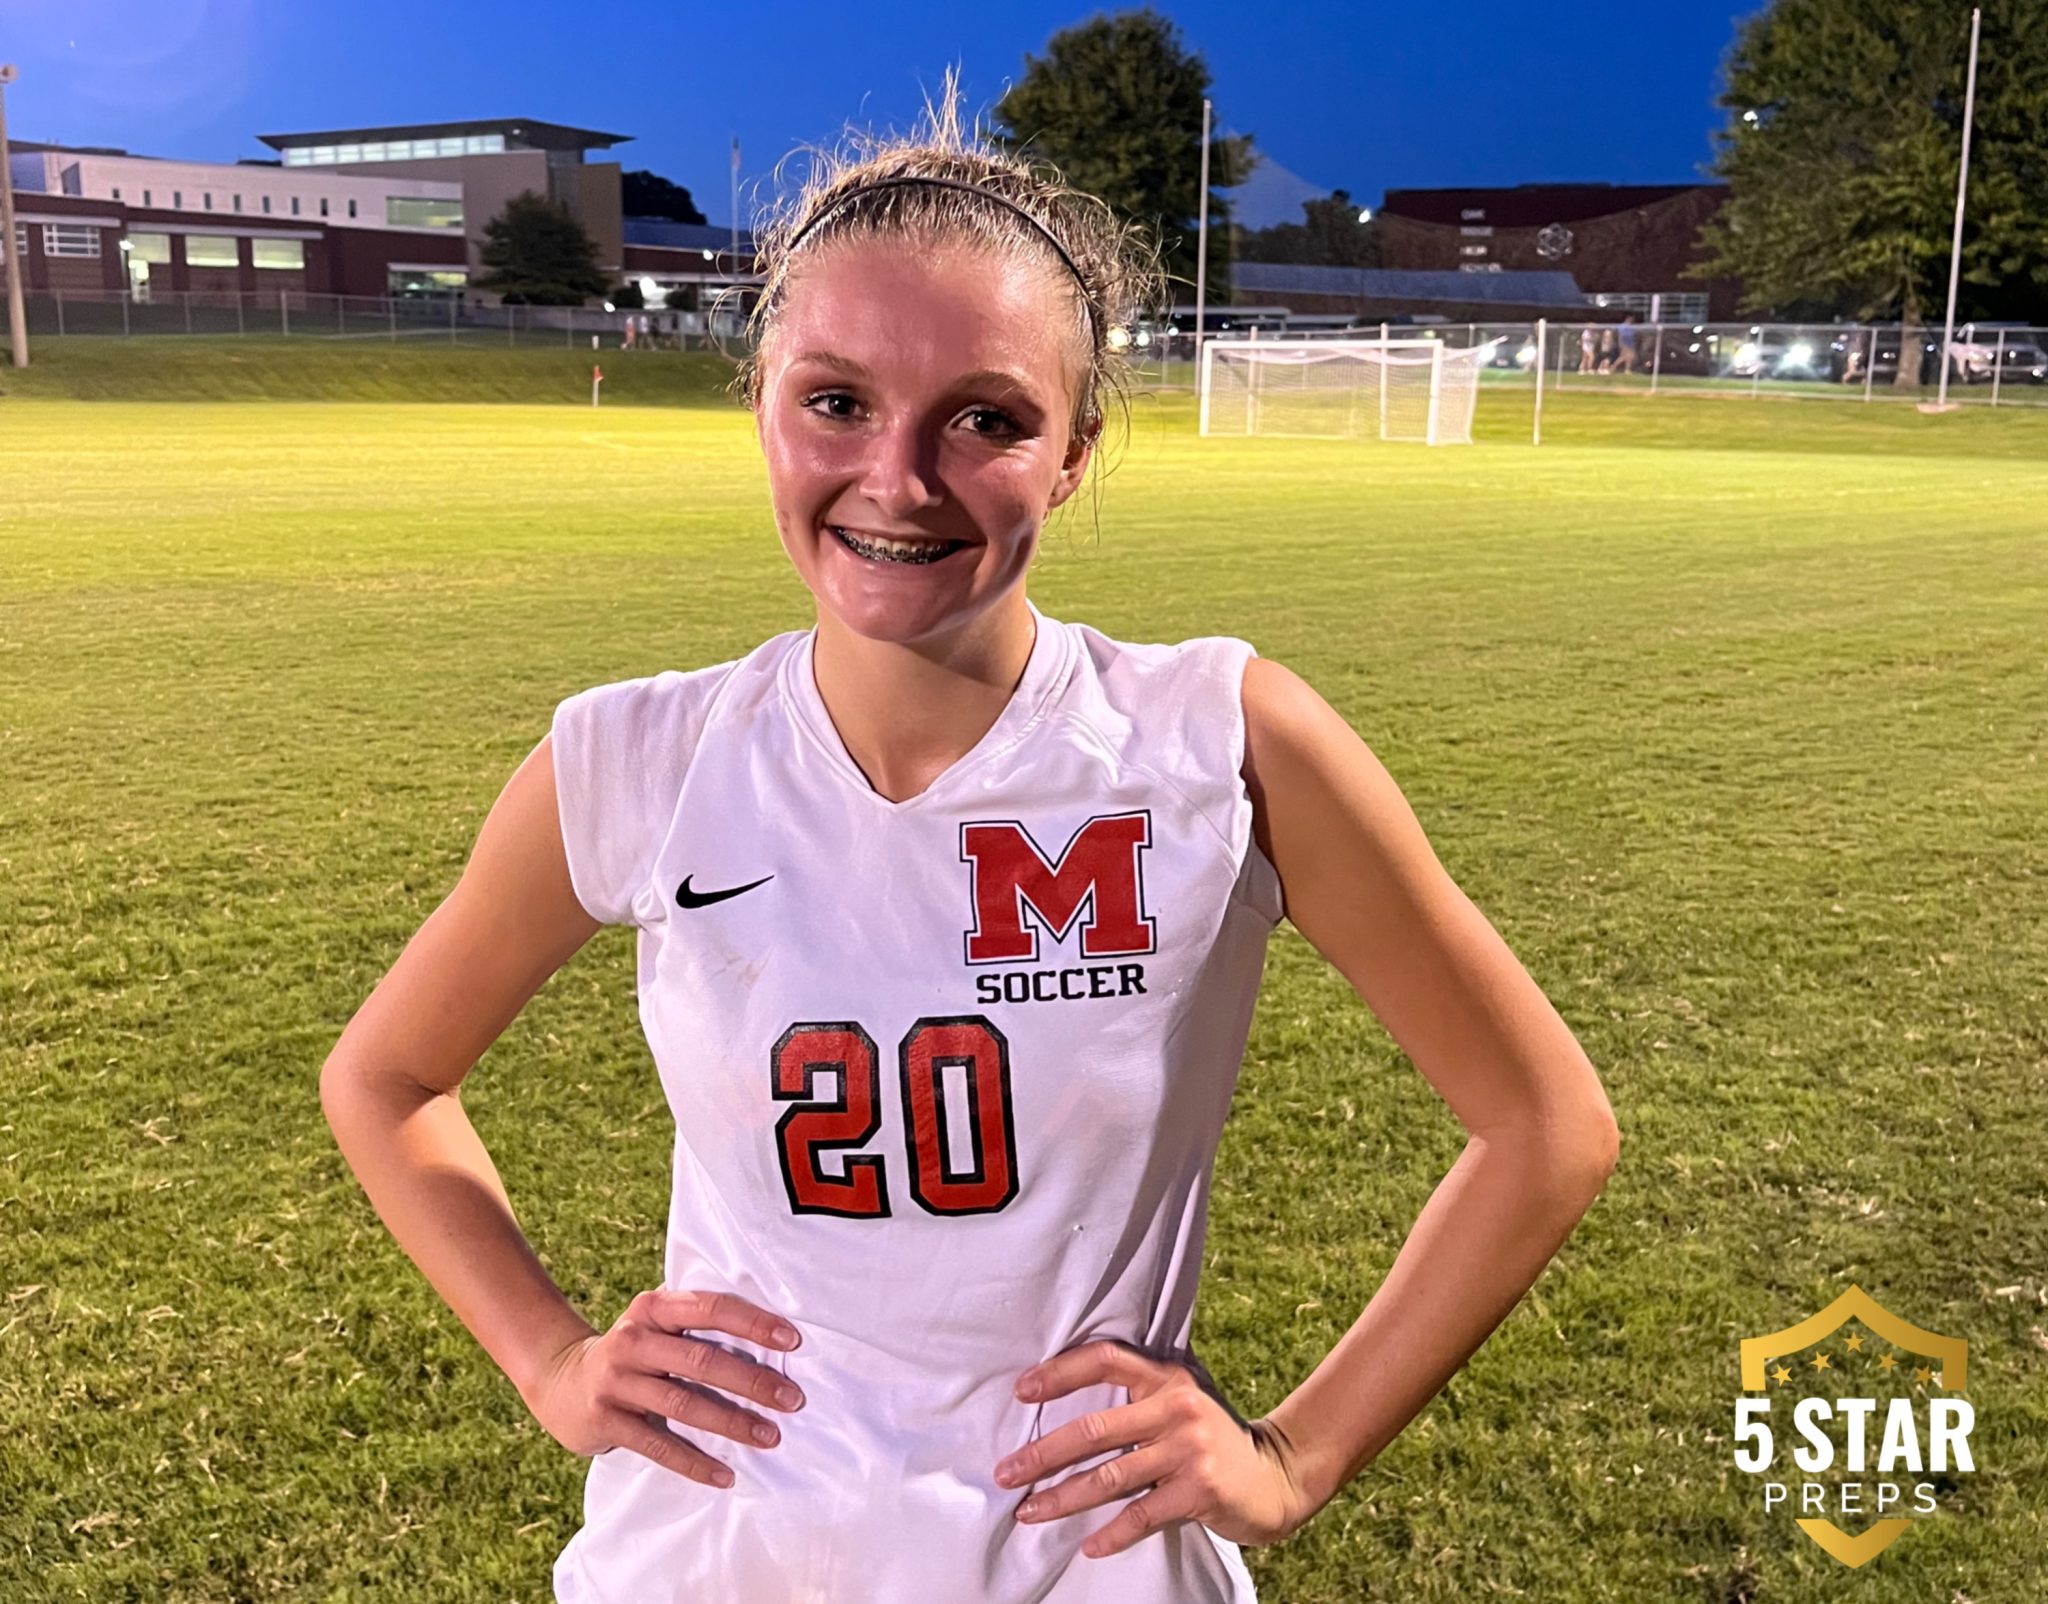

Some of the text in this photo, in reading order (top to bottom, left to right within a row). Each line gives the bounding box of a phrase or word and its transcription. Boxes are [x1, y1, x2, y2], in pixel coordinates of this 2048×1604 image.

[959, 809, 1158, 966] M
[976, 963, 1148, 1004] SOCCER
[771, 1014, 1020, 1218] 20
